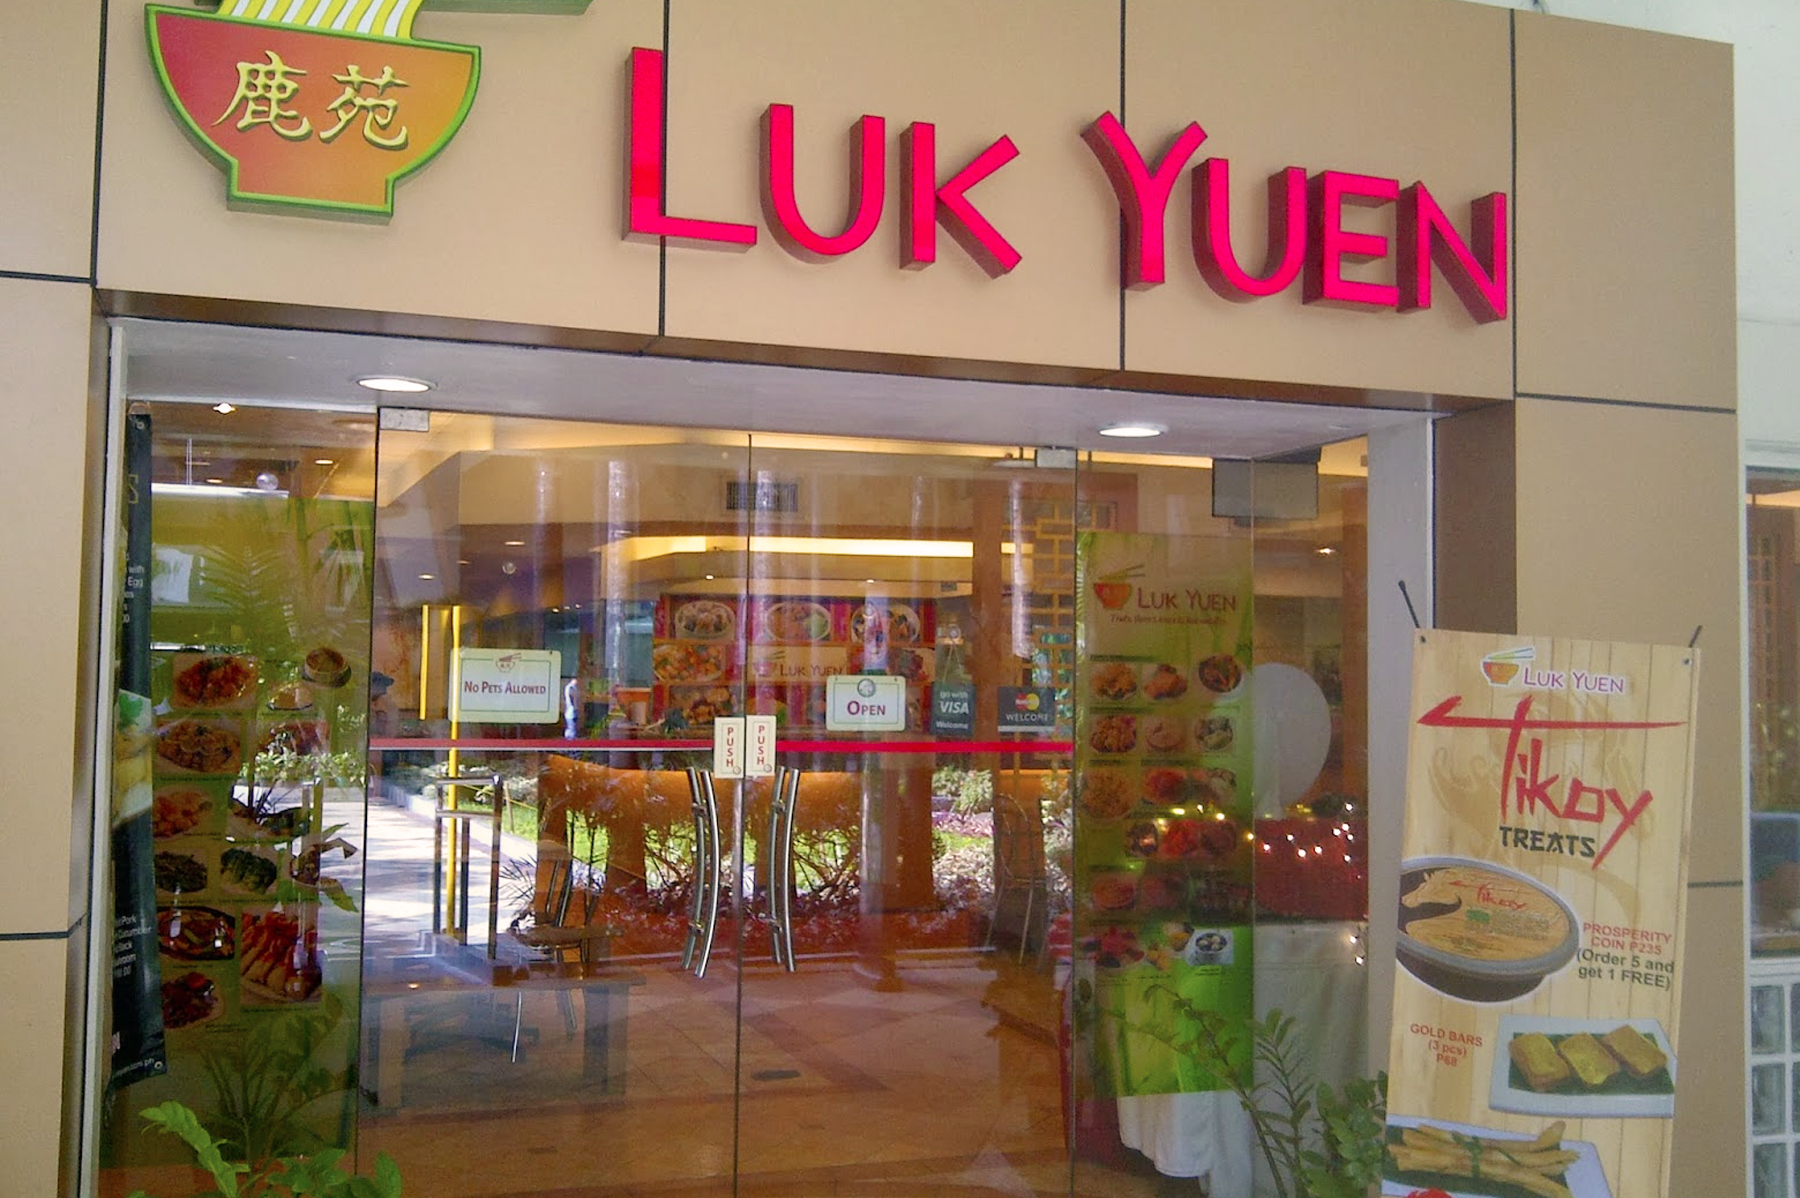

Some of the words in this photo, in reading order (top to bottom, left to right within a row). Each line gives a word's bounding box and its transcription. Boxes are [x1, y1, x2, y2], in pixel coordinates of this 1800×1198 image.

[211, 50, 410, 149] 鹿苑
[622, 47, 1023, 280] LUK
[1080, 111, 1507, 325] YUEN
[1137, 587, 1178, 611] LUK
[1186, 588, 1236, 613] YUEN
[779, 663, 806, 677] LUK
[1524, 667, 1564, 688] LUK
[1572, 670, 1624, 693] YUEN
[481, 681, 502, 694] PETS
[505, 681, 546, 695] ALLOWED
[847, 700, 886, 716] OPEN
[940, 701, 969, 715] VISA
[1005, 713, 1049, 722] WELCOME
[935, 720, 969, 730] Welcome
[725, 726, 734, 768] PUSH
[756, 724, 765, 766] PUSH
[1500, 826, 1597, 859] TREATS
[1583, 922, 1672, 944] PROSPERITY
[1591, 936, 1625, 951] COIN
[1576, 947, 1627, 966] (Order
[1631, 954, 1640, 968] 5
[1645, 960, 1675, 973] and
[1578, 966, 1602, 980] get
[1608, 968, 1615, 980] 1
[1621, 969, 1670, 992] FREE)
[1410, 1023, 1446, 1039] GOLD
[1448, 1030, 1483, 1047] BARS
